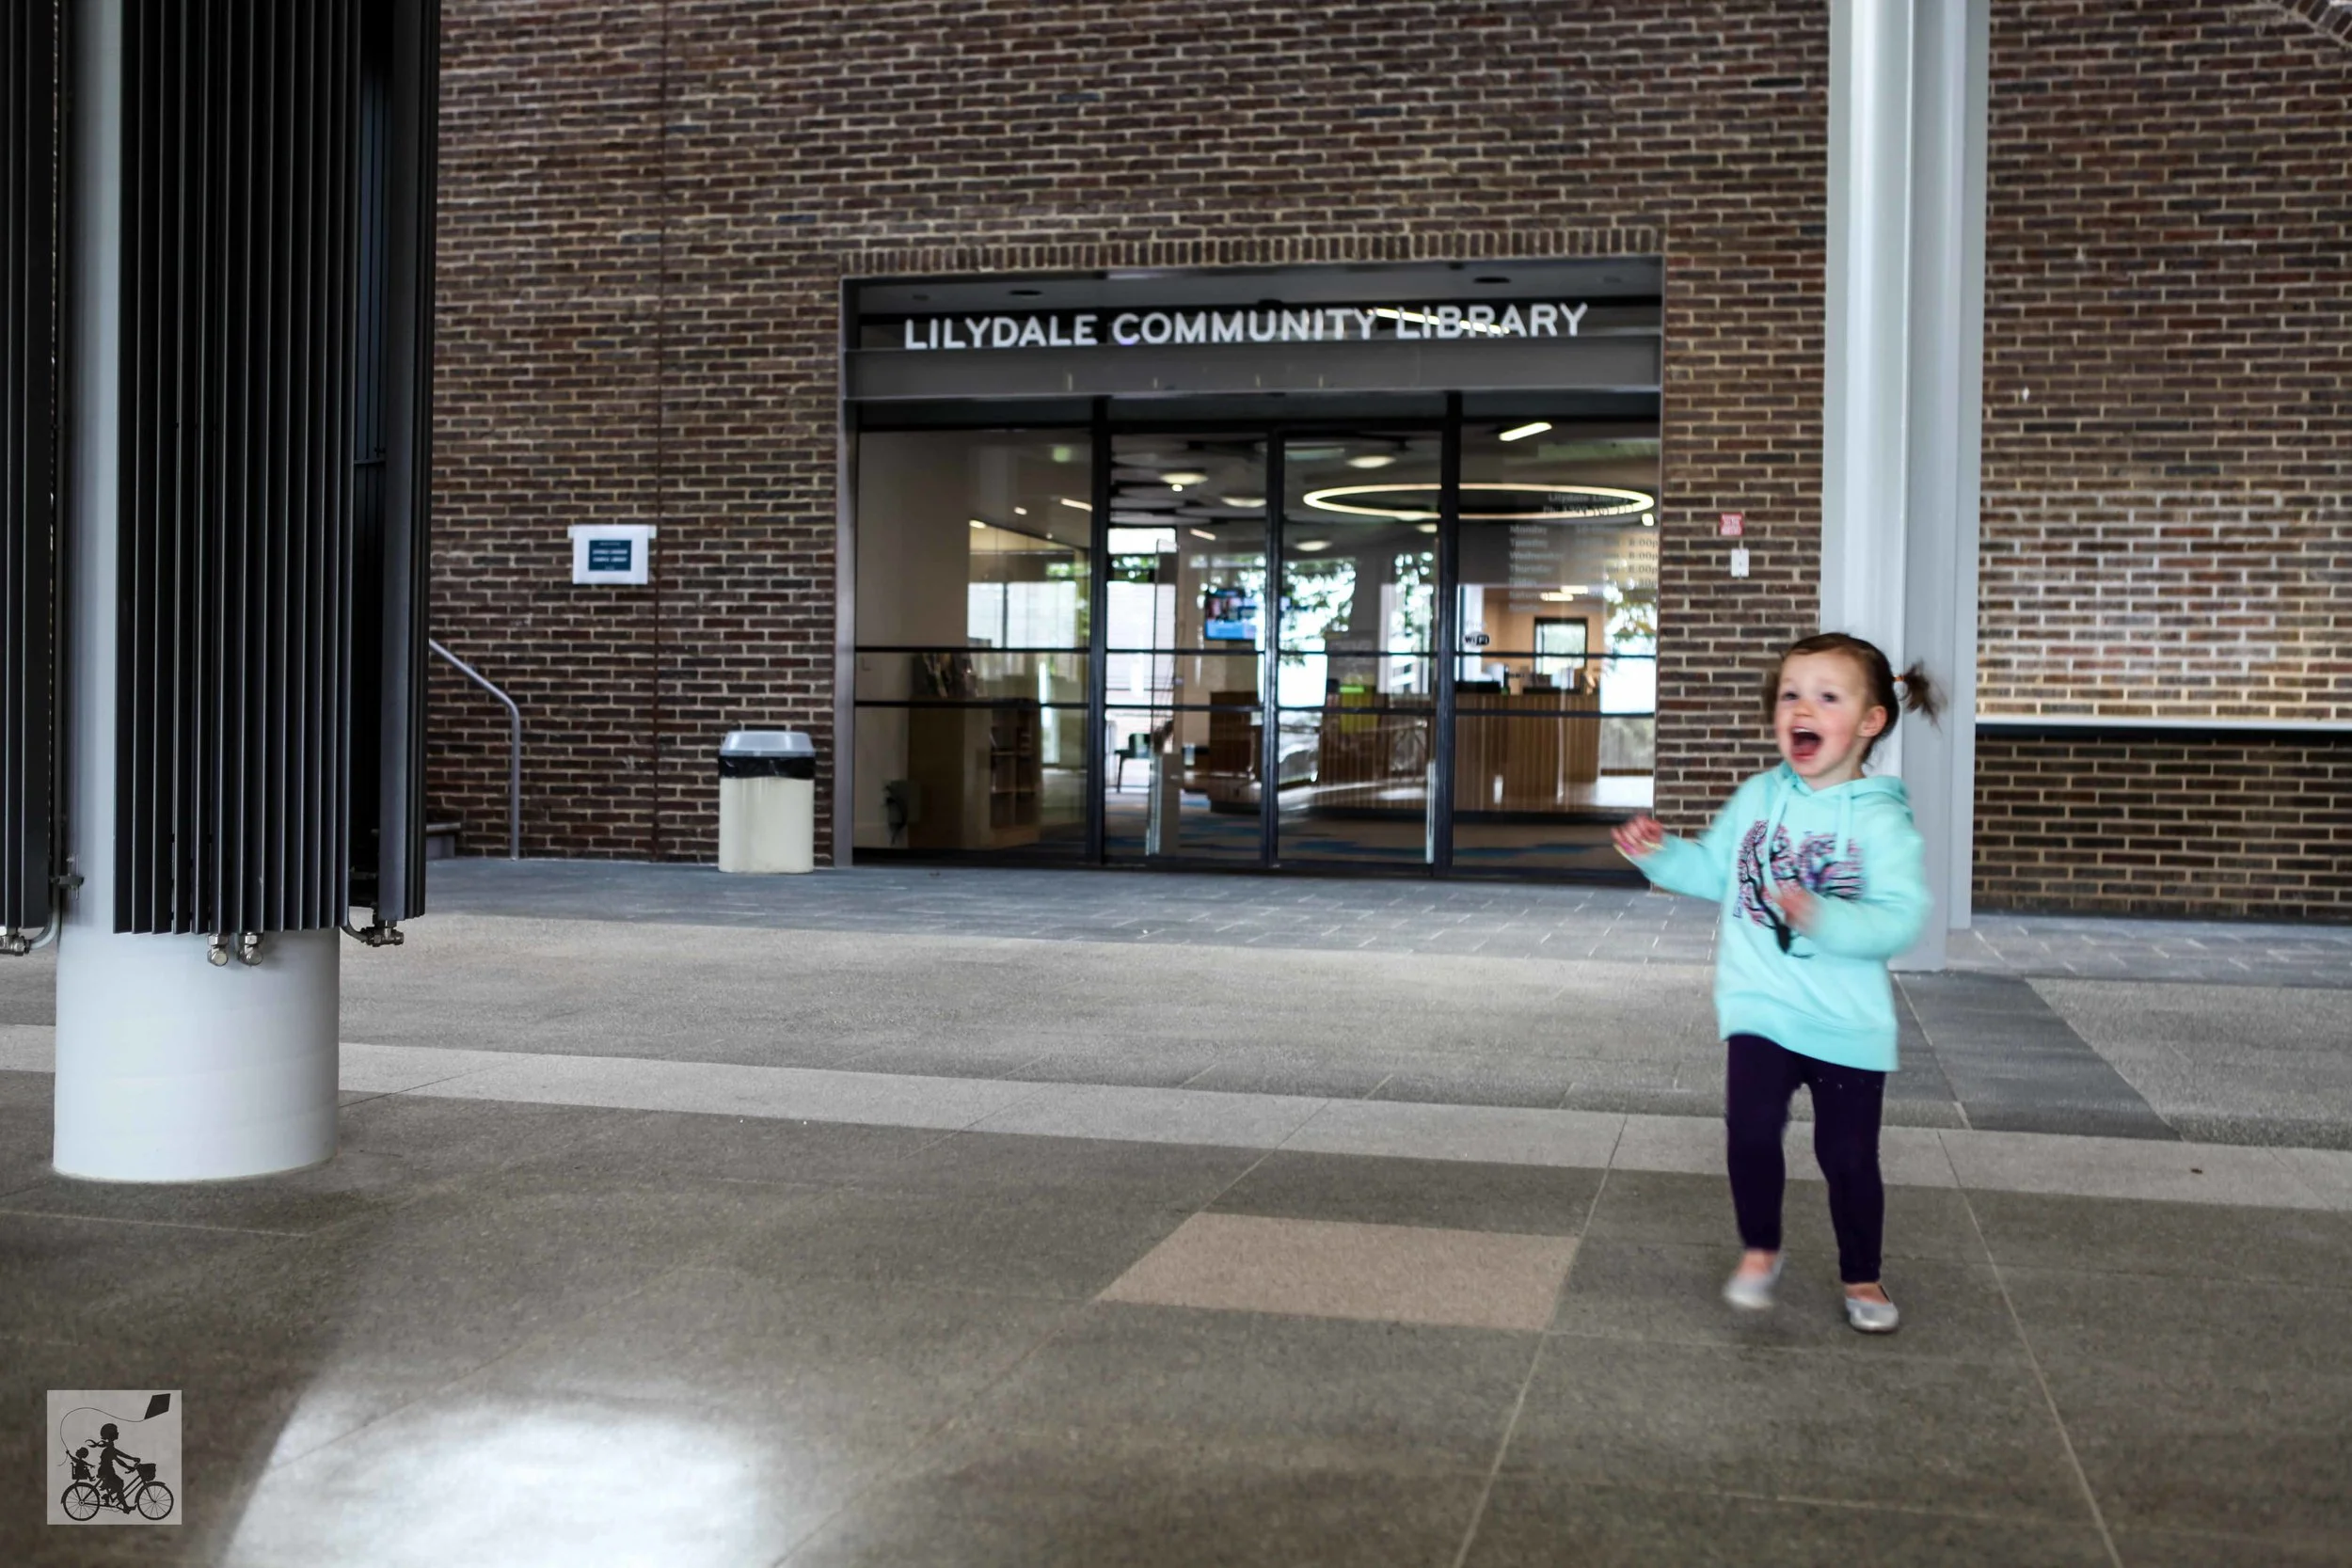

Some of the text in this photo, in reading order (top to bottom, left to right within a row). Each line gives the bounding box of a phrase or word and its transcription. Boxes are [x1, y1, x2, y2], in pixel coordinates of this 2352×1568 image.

[904, 302, 1588, 349] LILYDALE COMMUNITY LIBRARY
